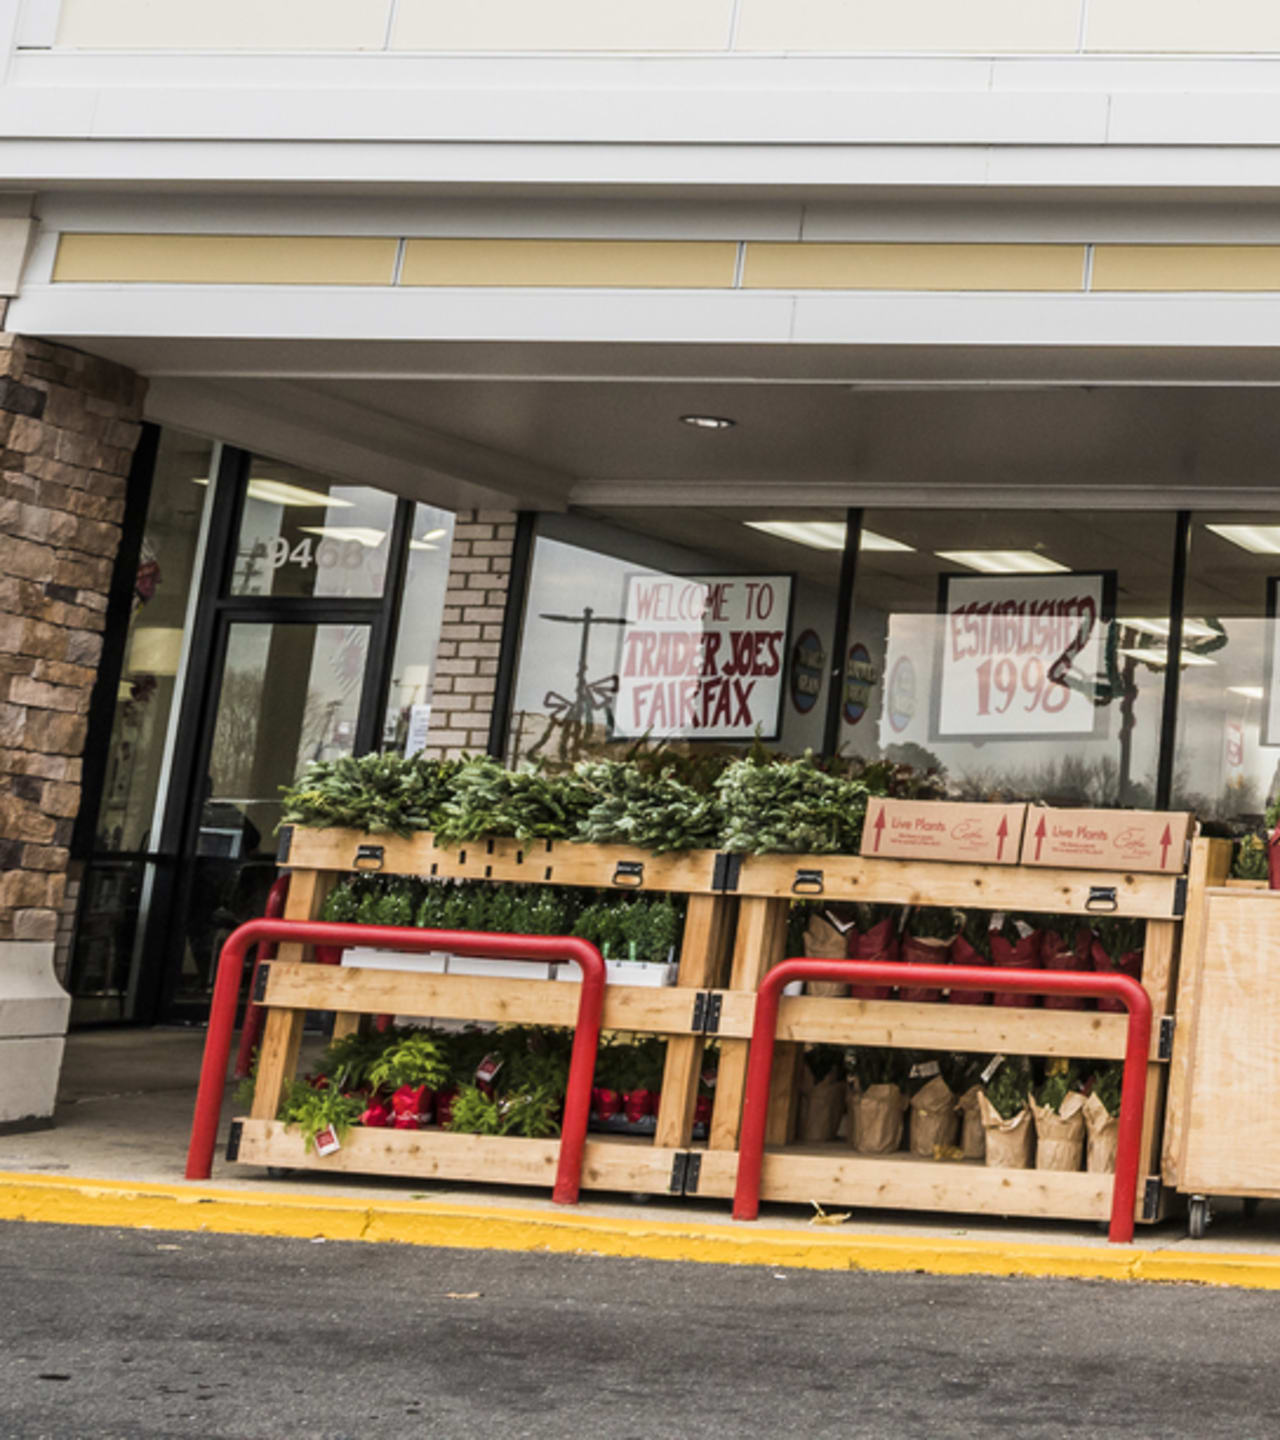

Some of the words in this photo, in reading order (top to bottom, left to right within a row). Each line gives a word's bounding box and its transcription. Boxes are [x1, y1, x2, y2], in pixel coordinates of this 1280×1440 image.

[636, 583, 734, 622] WELCOME
[745, 582, 774, 620] TO
[950, 595, 1097, 662] ESTABLISHED
[623, 631, 722, 677] TRADER
[721, 631, 783, 677] JOES
[632, 676, 757, 729] FAIRFAX
